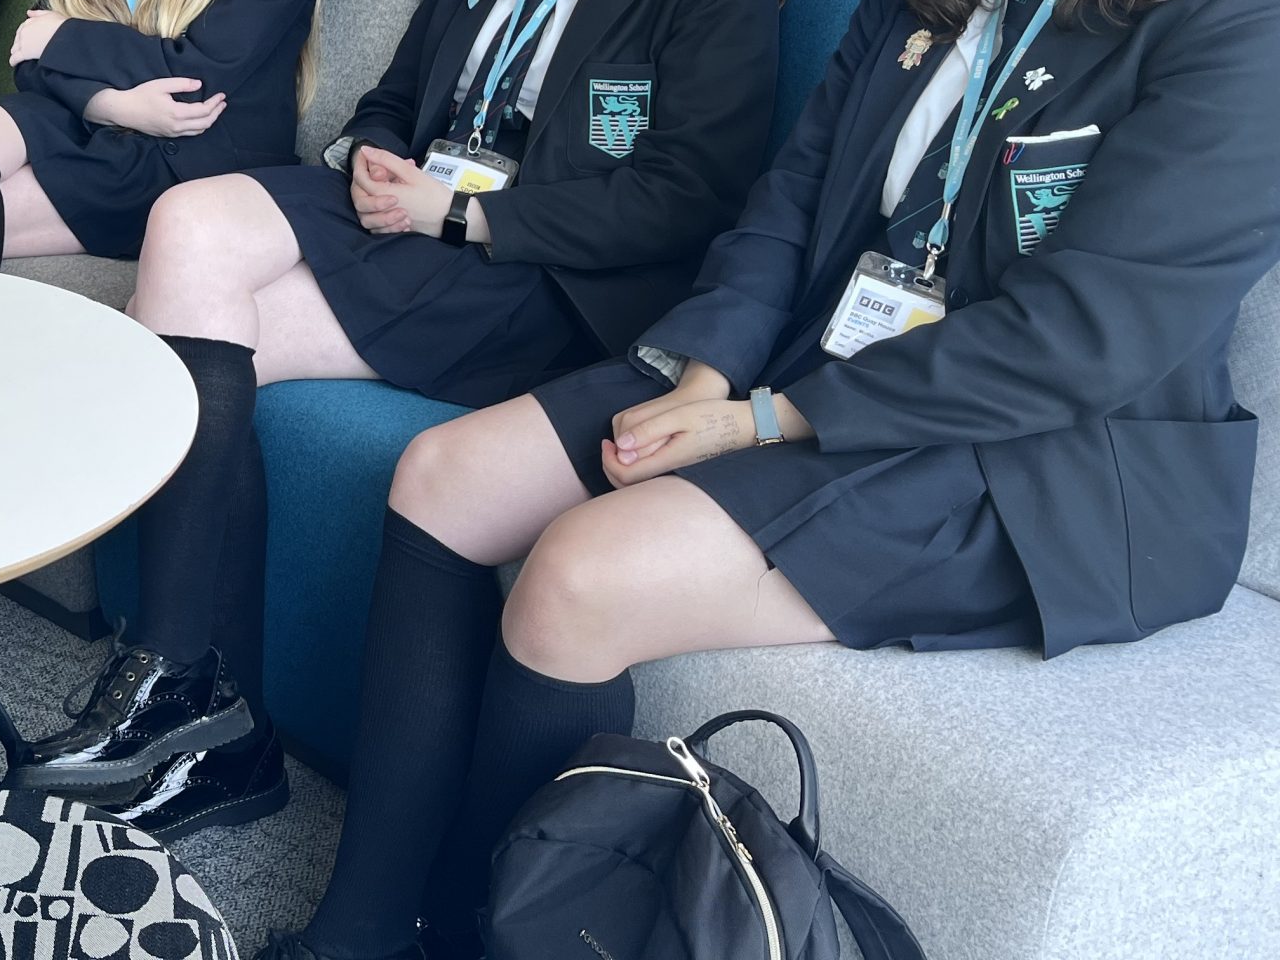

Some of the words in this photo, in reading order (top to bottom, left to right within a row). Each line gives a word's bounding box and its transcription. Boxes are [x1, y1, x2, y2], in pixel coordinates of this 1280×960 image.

[593, 82, 628, 93] Wellington
[628, 83, 649, 92] School
[1015, 171, 1066, 184] Wellington
[1066, 168, 1087, 179] Scho
[859, 295, 896, 317] BBC
